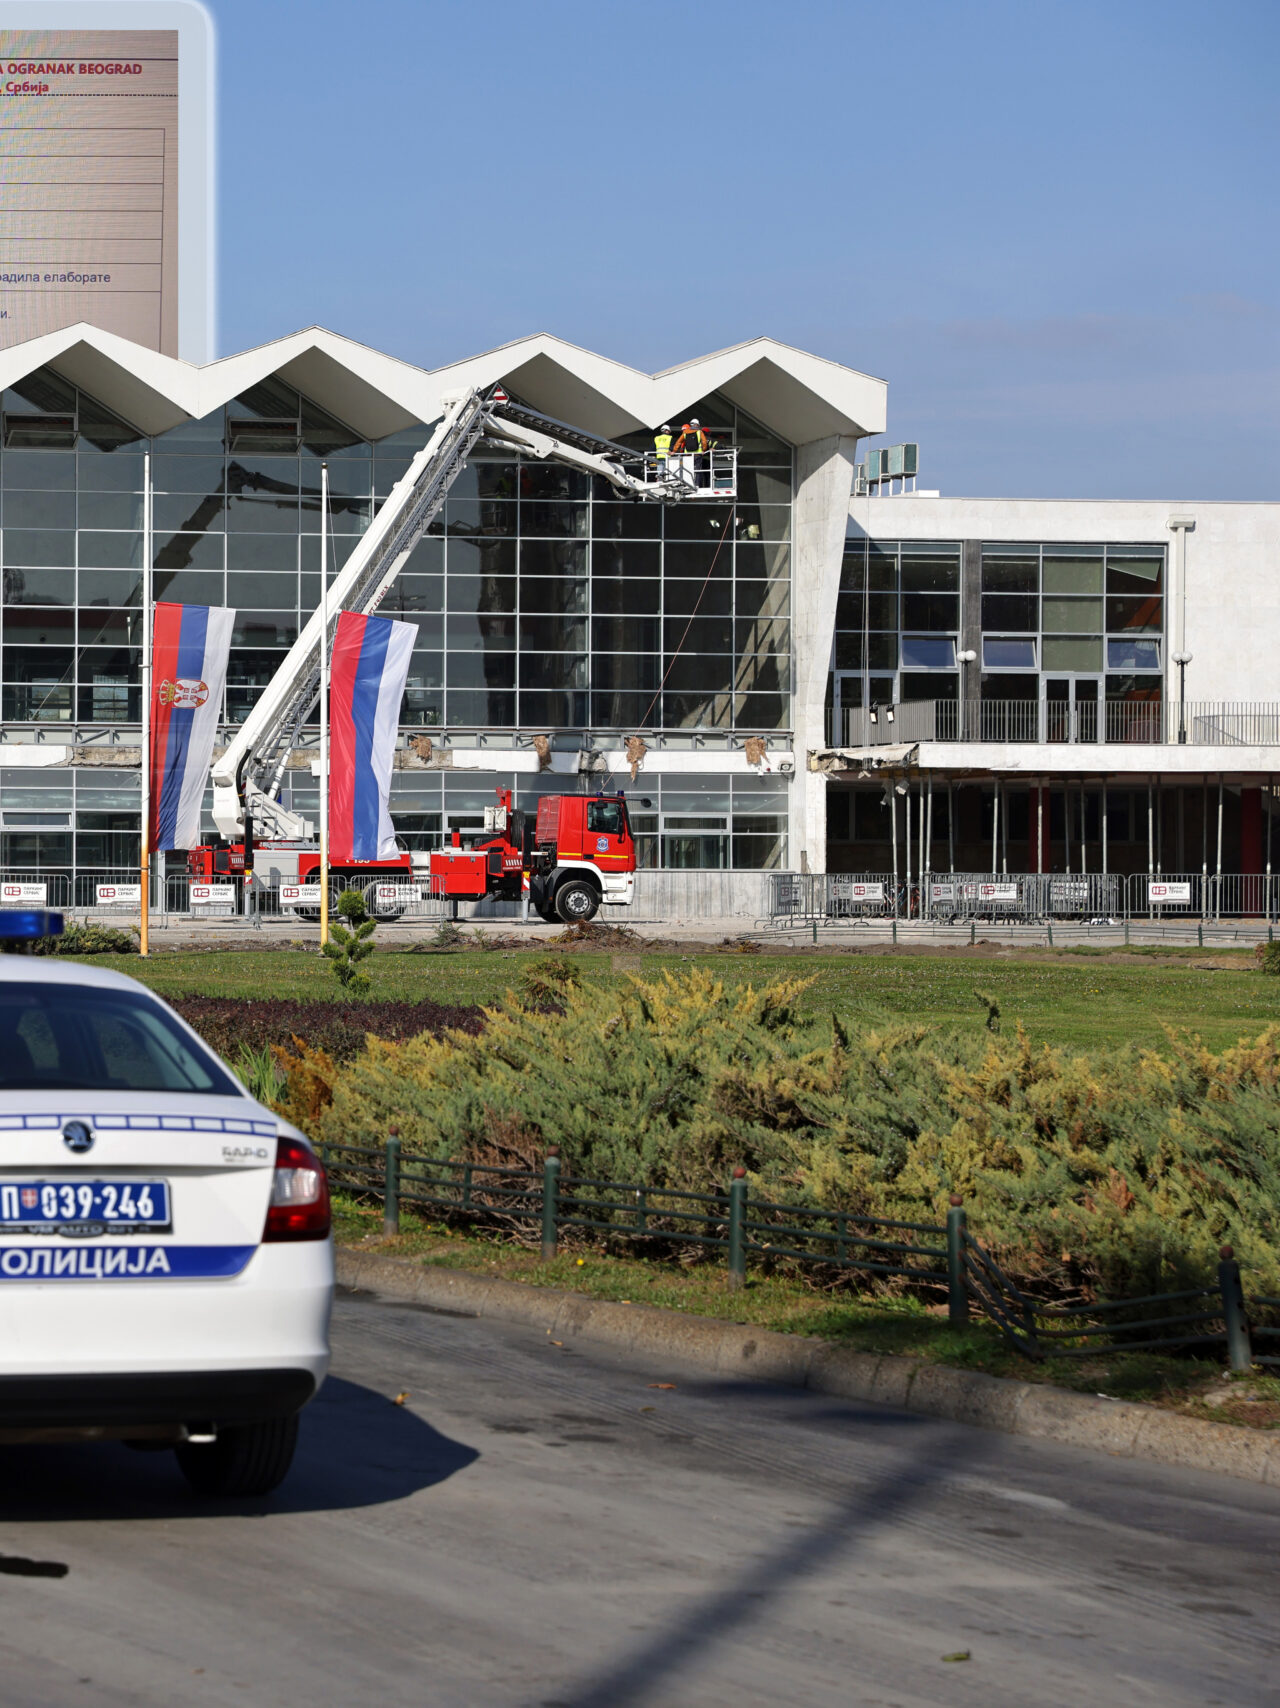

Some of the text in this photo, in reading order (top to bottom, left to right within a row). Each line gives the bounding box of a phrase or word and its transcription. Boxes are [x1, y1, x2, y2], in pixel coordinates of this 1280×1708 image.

[7, 63, 76, 75] OGRANAK
[79, 63, 142, 75] BEOGRAD
[5, 82, 49, 95] Србија
[44, 272, 111, 285] елаборате
